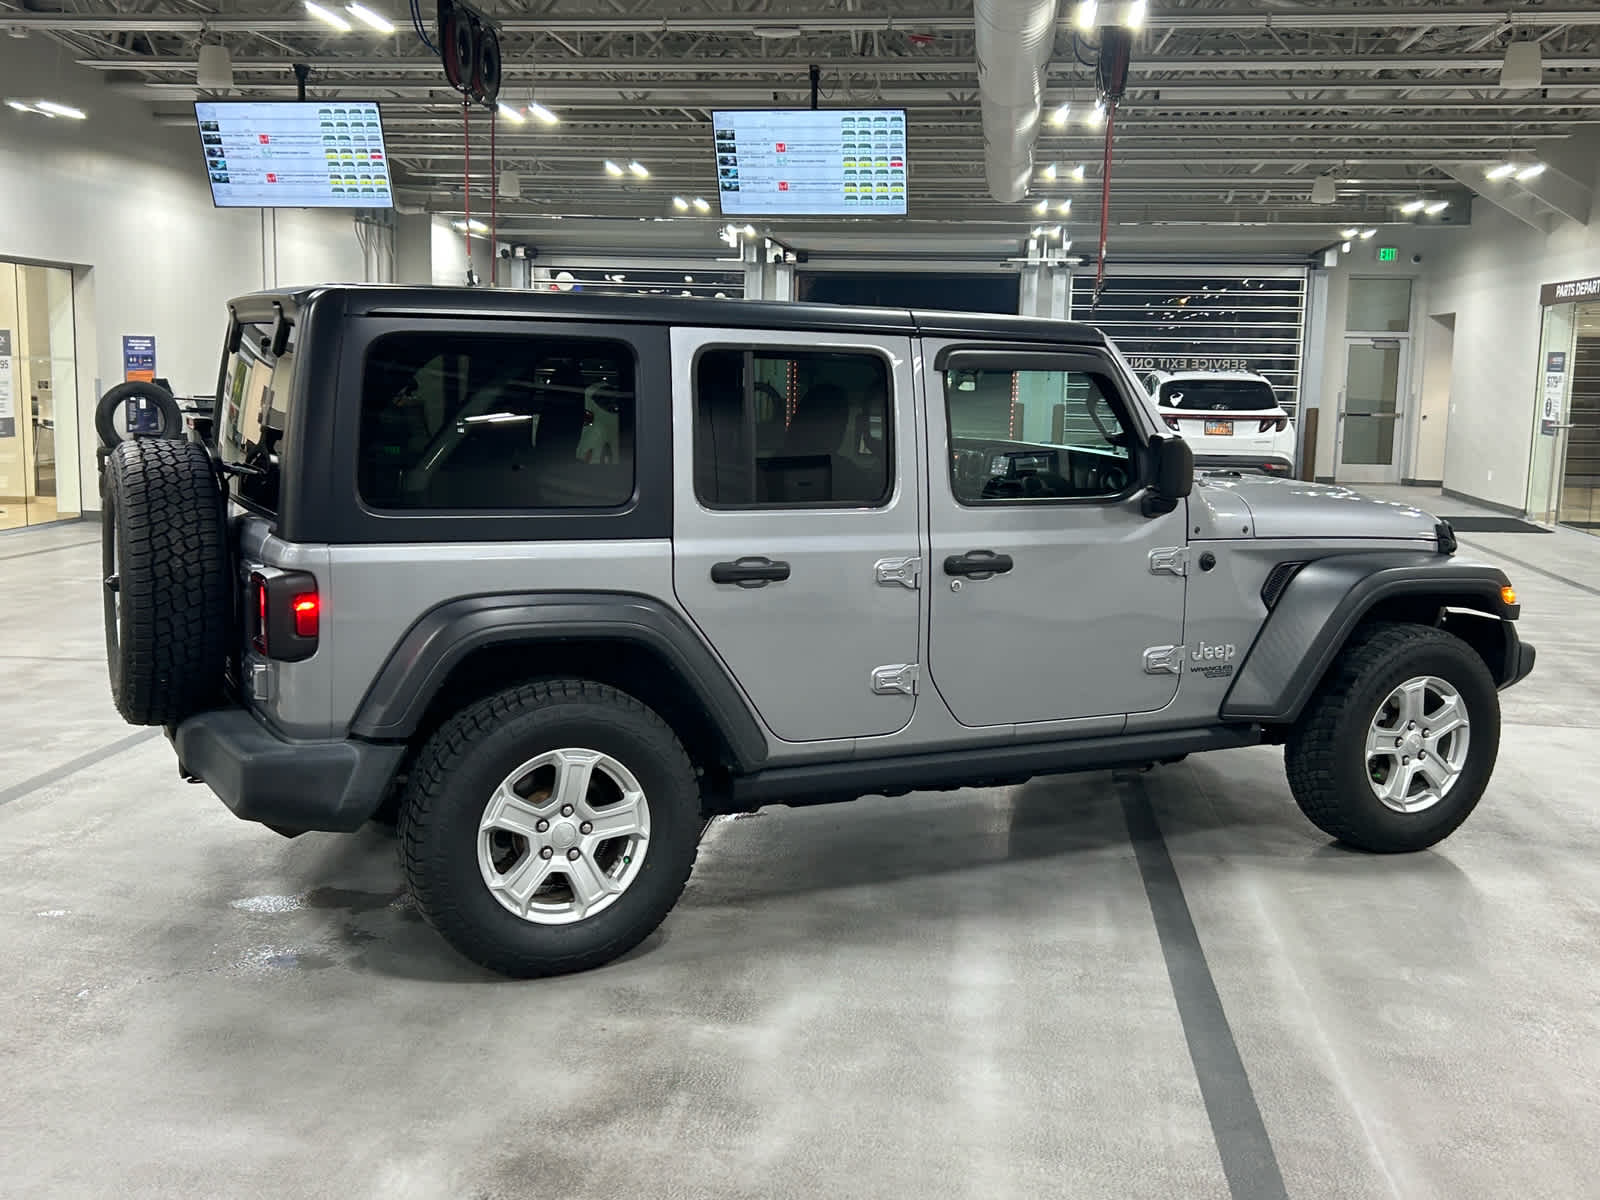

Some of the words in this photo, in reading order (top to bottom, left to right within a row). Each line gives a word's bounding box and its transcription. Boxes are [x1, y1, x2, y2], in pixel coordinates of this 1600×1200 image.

[1380, 248, 1397, 261] EXIT
[1555, 283, 1576, 298] PARTS
[1191, 641, 1236, 661] Jeep
